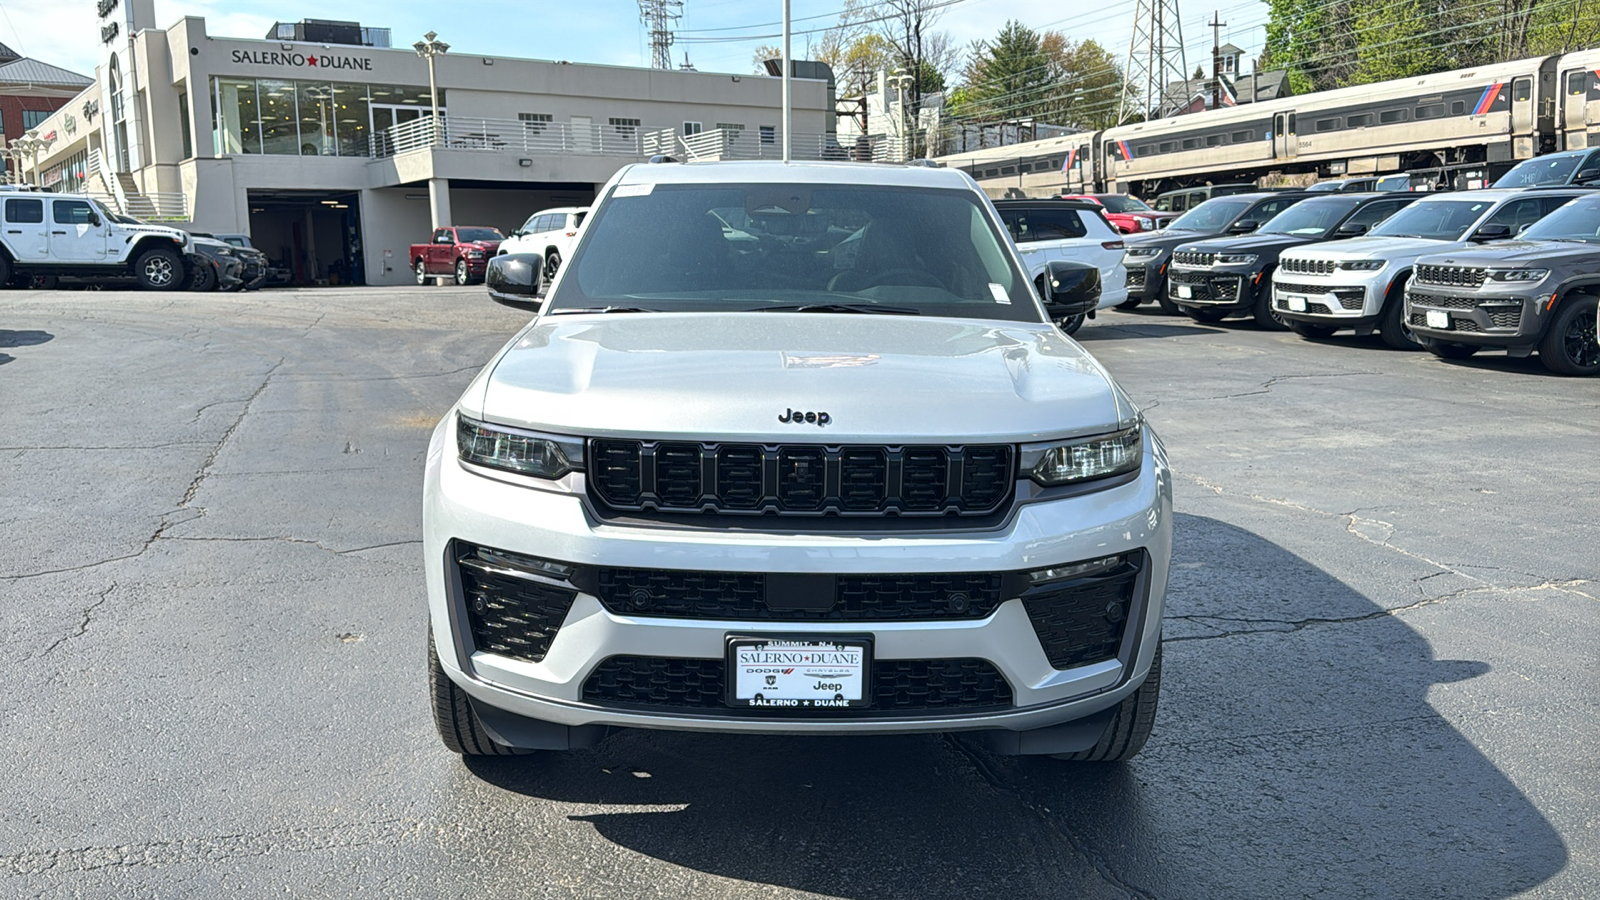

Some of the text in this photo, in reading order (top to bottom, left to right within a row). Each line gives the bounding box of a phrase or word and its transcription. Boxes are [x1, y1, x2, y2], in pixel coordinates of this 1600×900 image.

[231, 50, 373, 71] SALERNO DUANE
[778, 408, 831, 427] Jeep
[740, 652, 859, 665] SALERNO DUANE
[813, 681, 842, 692] Jeep
[749, 699, 850, 707] SALERNO DUANE
